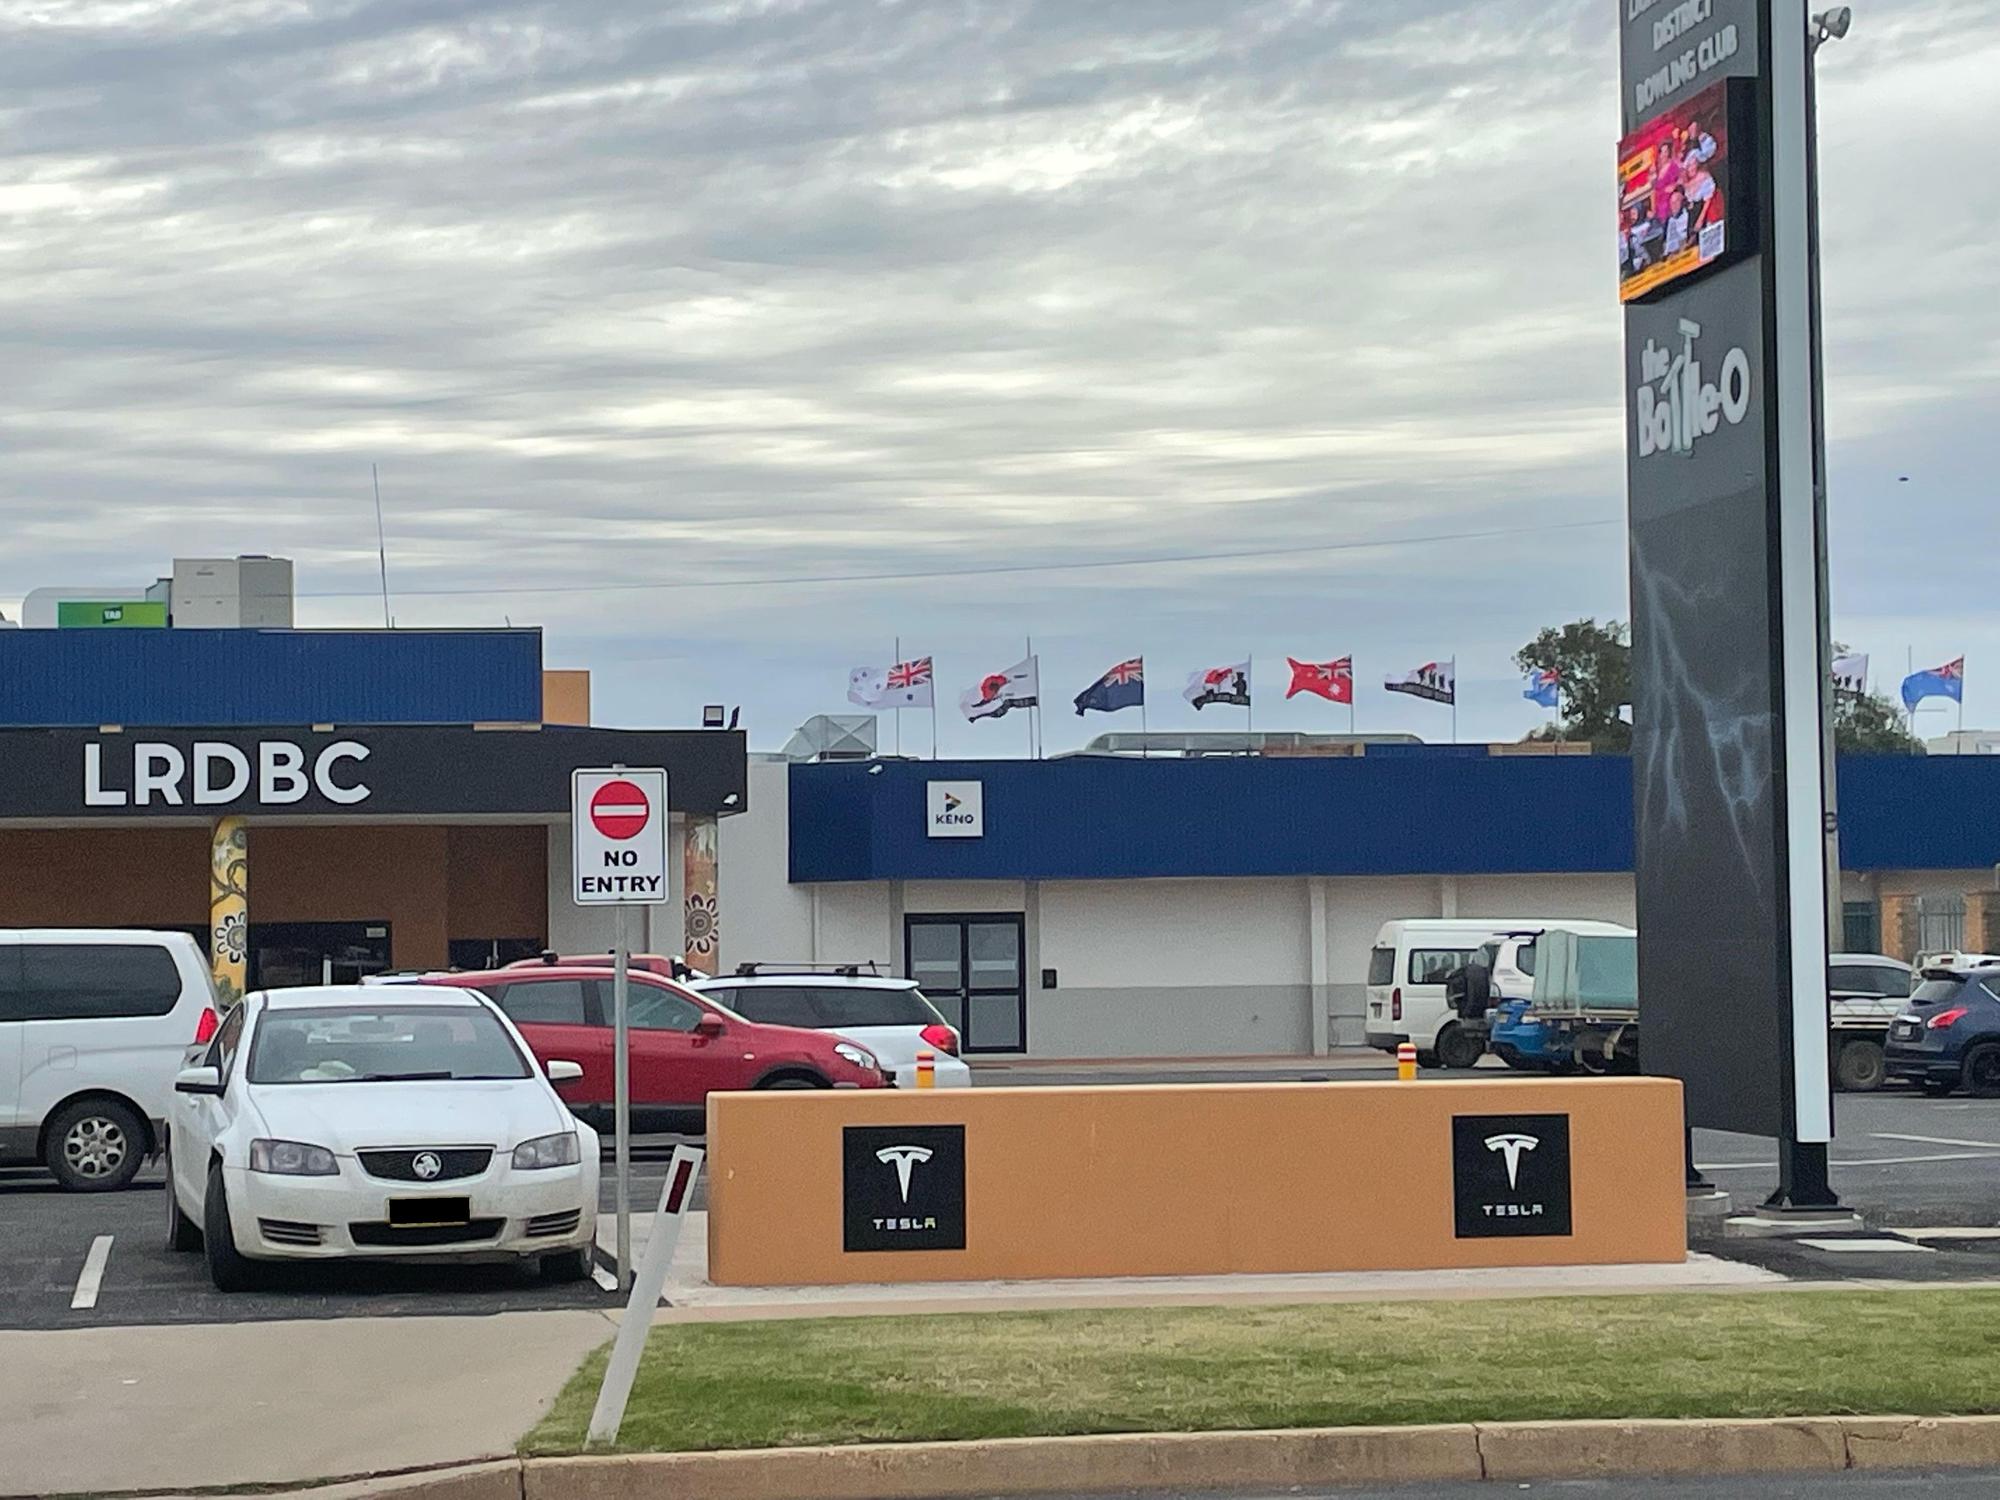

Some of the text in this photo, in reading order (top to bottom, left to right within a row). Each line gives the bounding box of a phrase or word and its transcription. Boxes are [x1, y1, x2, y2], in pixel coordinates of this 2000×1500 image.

[1636, 24, 1738, 113] BOWLING CLUB
[84, 741, 372, 806] LRDBC
[936, 814, 974, 825] KENO
[604, 850, 638, 867] NO
[581, 875, 661, 893] ENTRY
[1482, 1204, 1543, 1216] TESLA
[873, 1217, 936, 1230] TESLA
